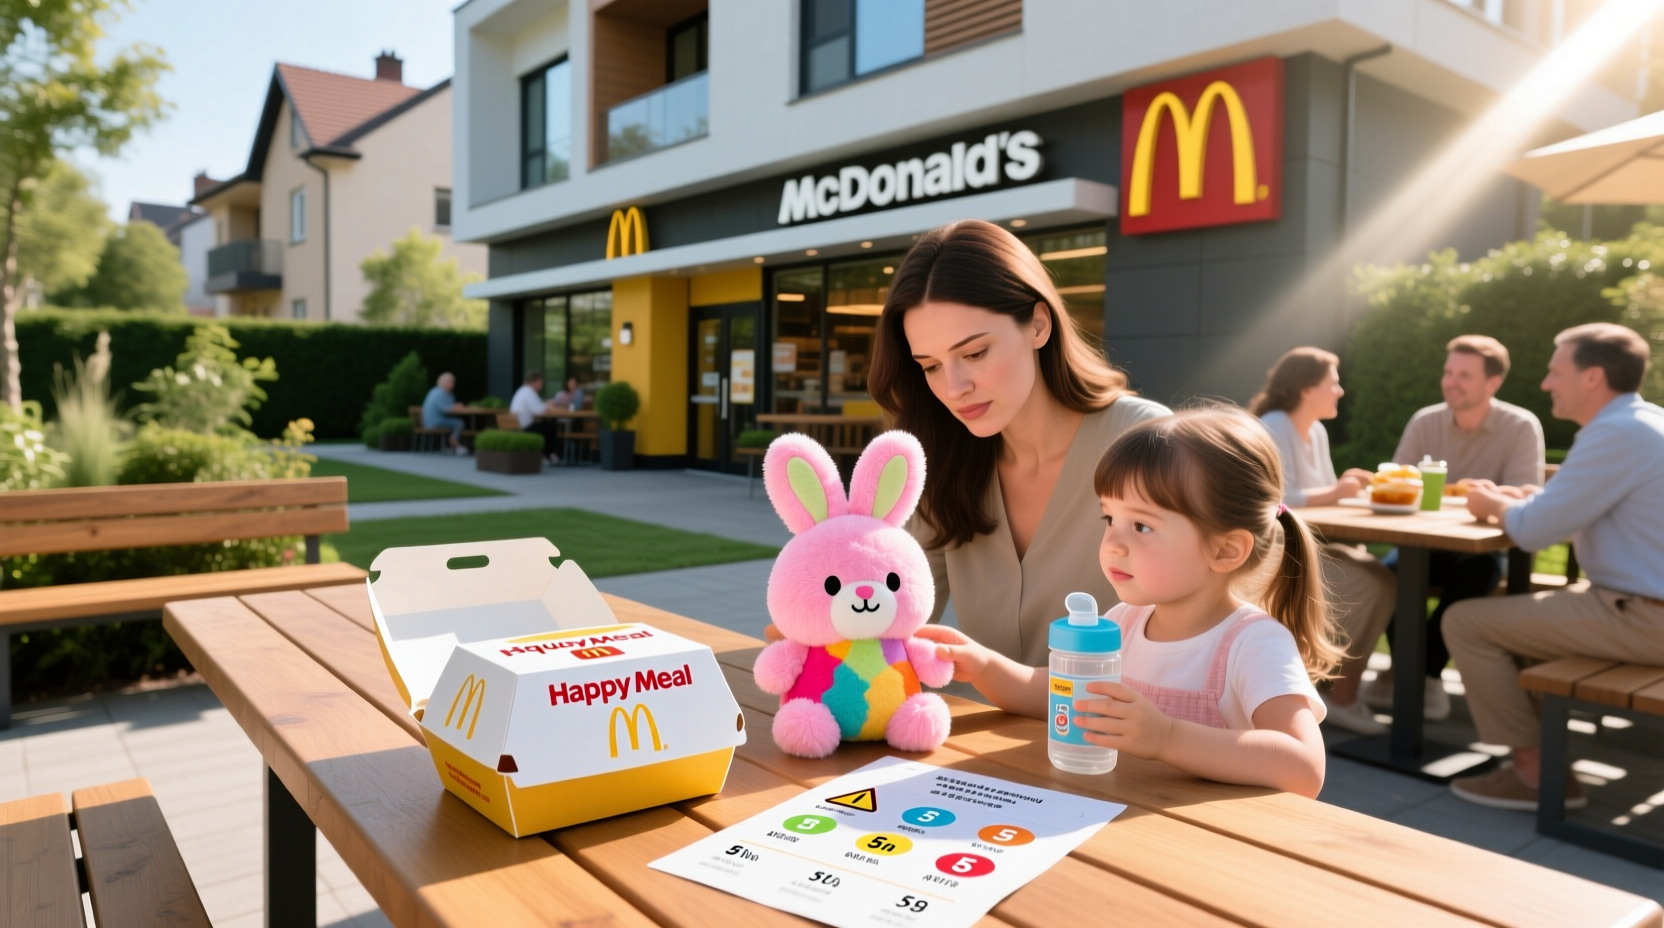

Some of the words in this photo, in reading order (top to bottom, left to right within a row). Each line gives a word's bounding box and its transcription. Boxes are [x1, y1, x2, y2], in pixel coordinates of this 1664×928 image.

[778, 130, 1043, 225] McDonald's
[548, 676, 631, 706] Happy
[635, 664, 693, 693] Meal
[951, 857, 978, 873] 5
